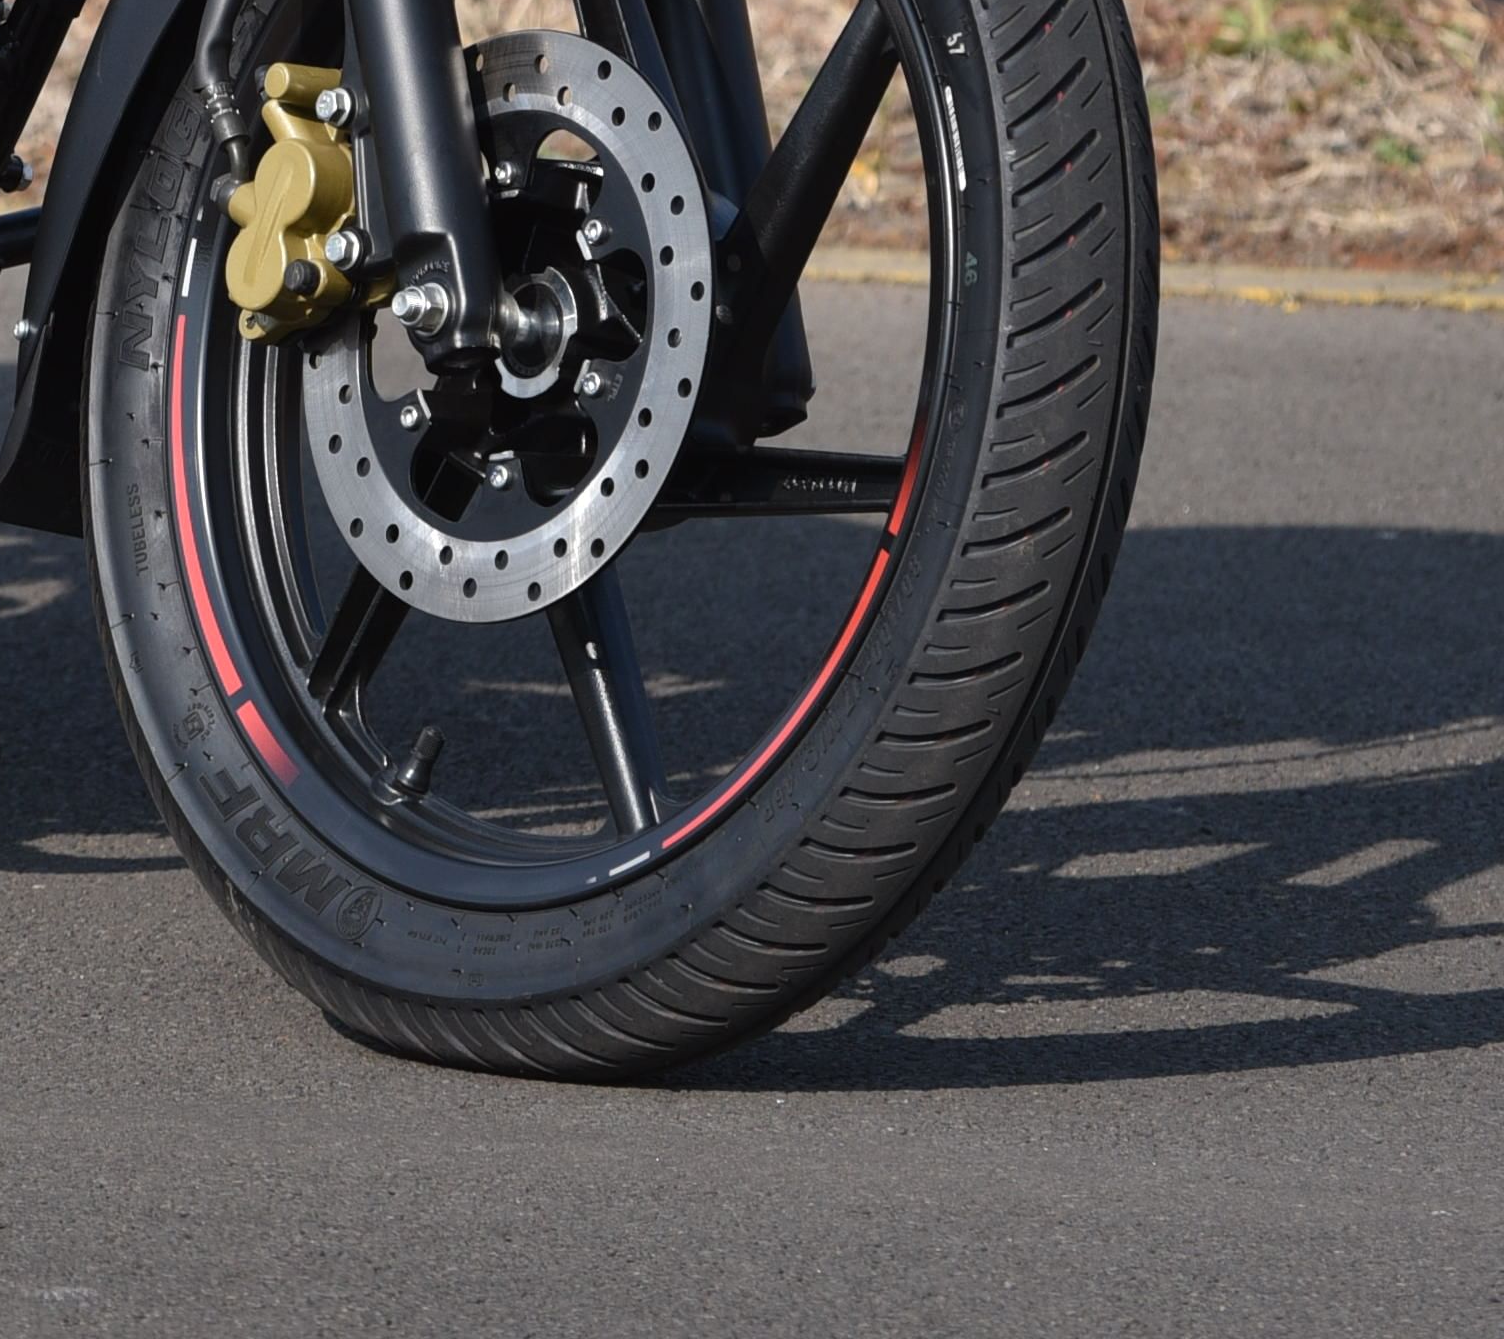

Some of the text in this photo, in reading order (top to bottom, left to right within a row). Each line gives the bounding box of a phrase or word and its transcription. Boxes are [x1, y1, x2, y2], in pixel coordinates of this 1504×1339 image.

[118, 78, 204, 371] NYLOG
[127, 482, 150, 578] TUBELESS
[199, 769, 338, 915] MRF
